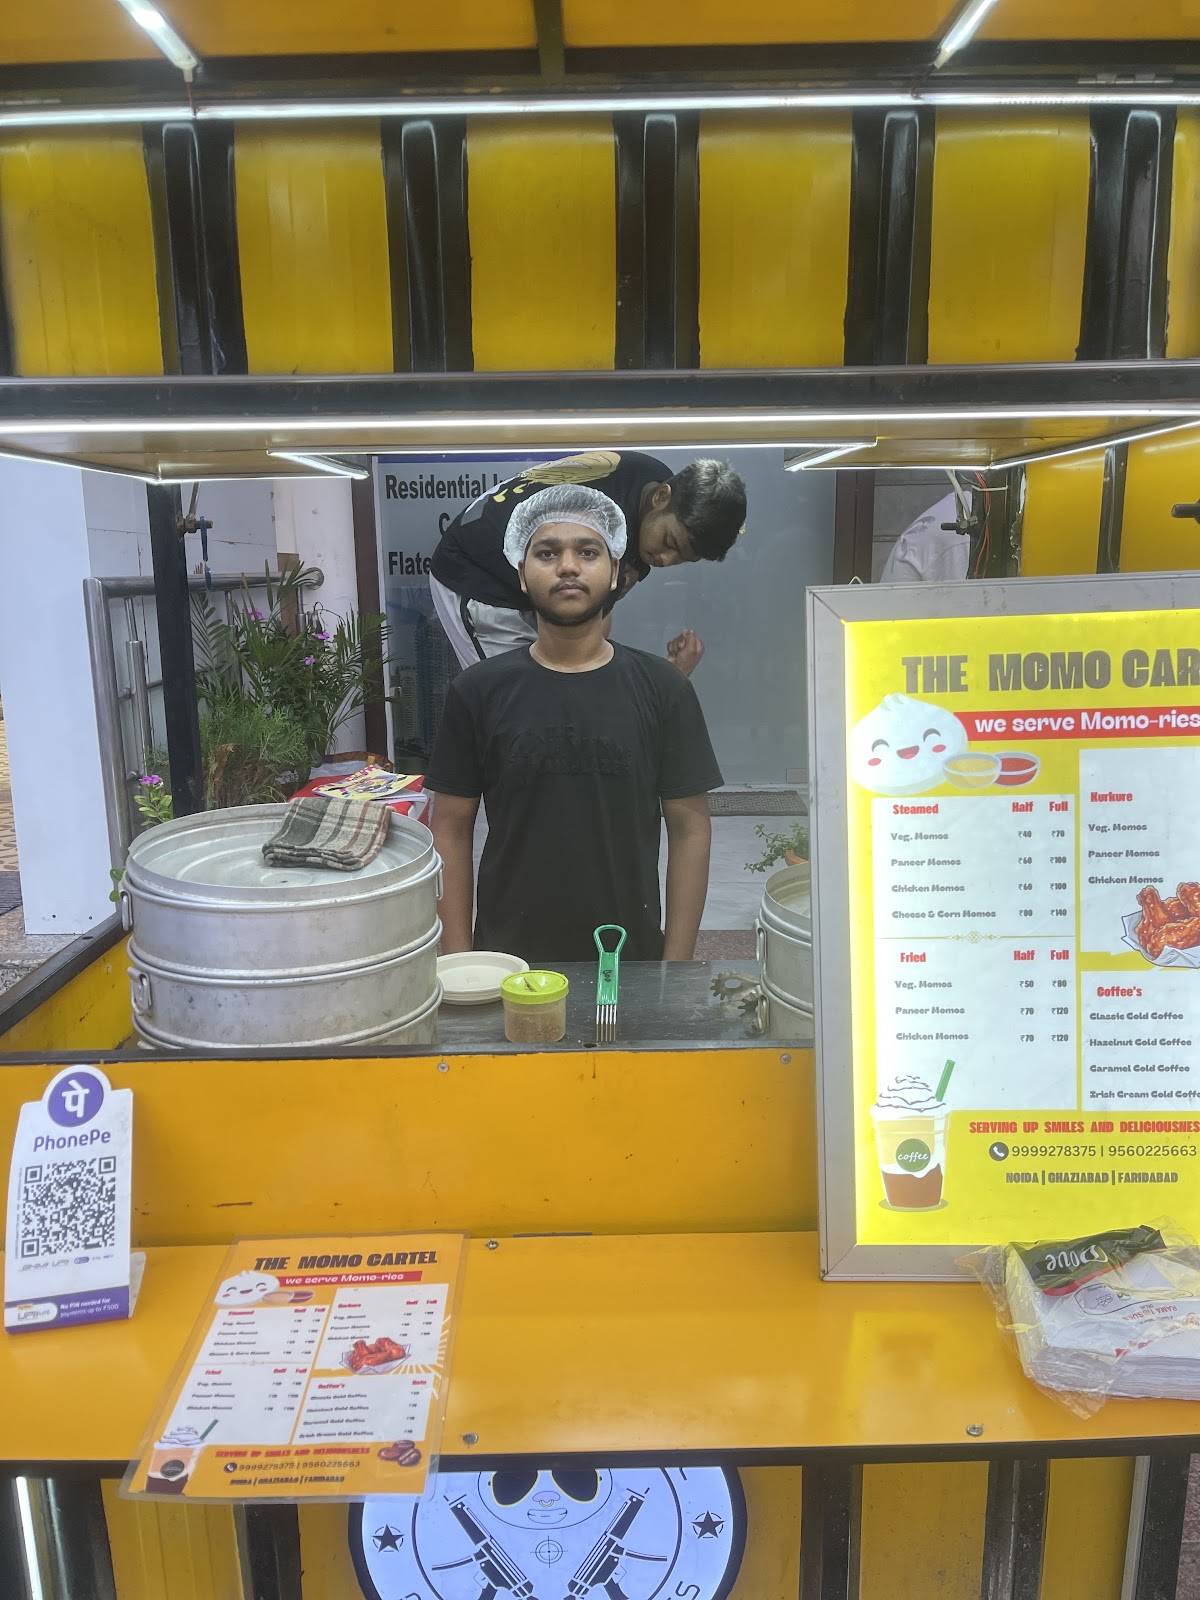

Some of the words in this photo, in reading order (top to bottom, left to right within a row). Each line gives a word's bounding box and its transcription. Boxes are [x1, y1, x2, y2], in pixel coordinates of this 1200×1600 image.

[385, 474, 486, 500] Residential
[902, 655, 969, 694] THE
[988, 650, 1111, 691] MOMO
[975, 716, 1006, 733] we
[1012, 715, 1075, 732] serve
[1081, 709, 1200, 731] Momo-ries
[1090, 791, 1133, 802] Kurkure
[892, 803, 939, 815] Steamed
[1012, 802, 1034, 813] Half
[1049, 801, 1069, 812] Full
[1112, 823, 1148, 831] Momos
[915, 832, 949, 840] Momos
[1125, 850, 1160, 858] Momos
[927, 858, 961, 866] Momos
[1088, 876, 1127, 884] Chicken
[1128, 875, 1164, 884] Momos
[891, 884, 930, 893] Chicken
[931, 884, 965, 892] Momos
[962, 910, 997, 918] Momos
[900, 952, 927, 963] Fried
[1014, 950, 1036, 961] Half
[1050, 949, 1070, 960] Full
[1097, 986, 1143, 997] Coffee's
[931, 1006, 966, 1014] Momos
[1089, 1012, 1125, 1020] Classic
[1151, 1012, 1184, 1020] Coffee
[896, 1032, 934, 1041] Chicken
[935, 1032, 969, 1040] Momos
[1159, 1038, 1192, 1046] Coffee
[1157, 1064, 1190, 1072] Coffee
[969, 1121, 1018, 1133] SERVING
[1023, 1121, 1039, 1133] UP
[1044, 1121, 1084, 1133] SMILES
[1090, 1121, 1114, 1133] AND
[33, 1129, 111, 1152] PhonePe
[897, 1151, 929, 1162] coffee
[1012, 1145, 1096, 1157] 9999278375
[1108, 1145, 1197, 1157] 9560225663
[1006, 1172, 1039, 1183] NOIDA
[1048, 1172, 1109, 1183] GHAZIABAD
[1117, 1172, 1178, 1183] FARIDABAD
[253, 1256, 291, 1271] THE
[297, 1254, 363, 1270] MOMO
[366, 1250, 438, 1267] CARTEL
